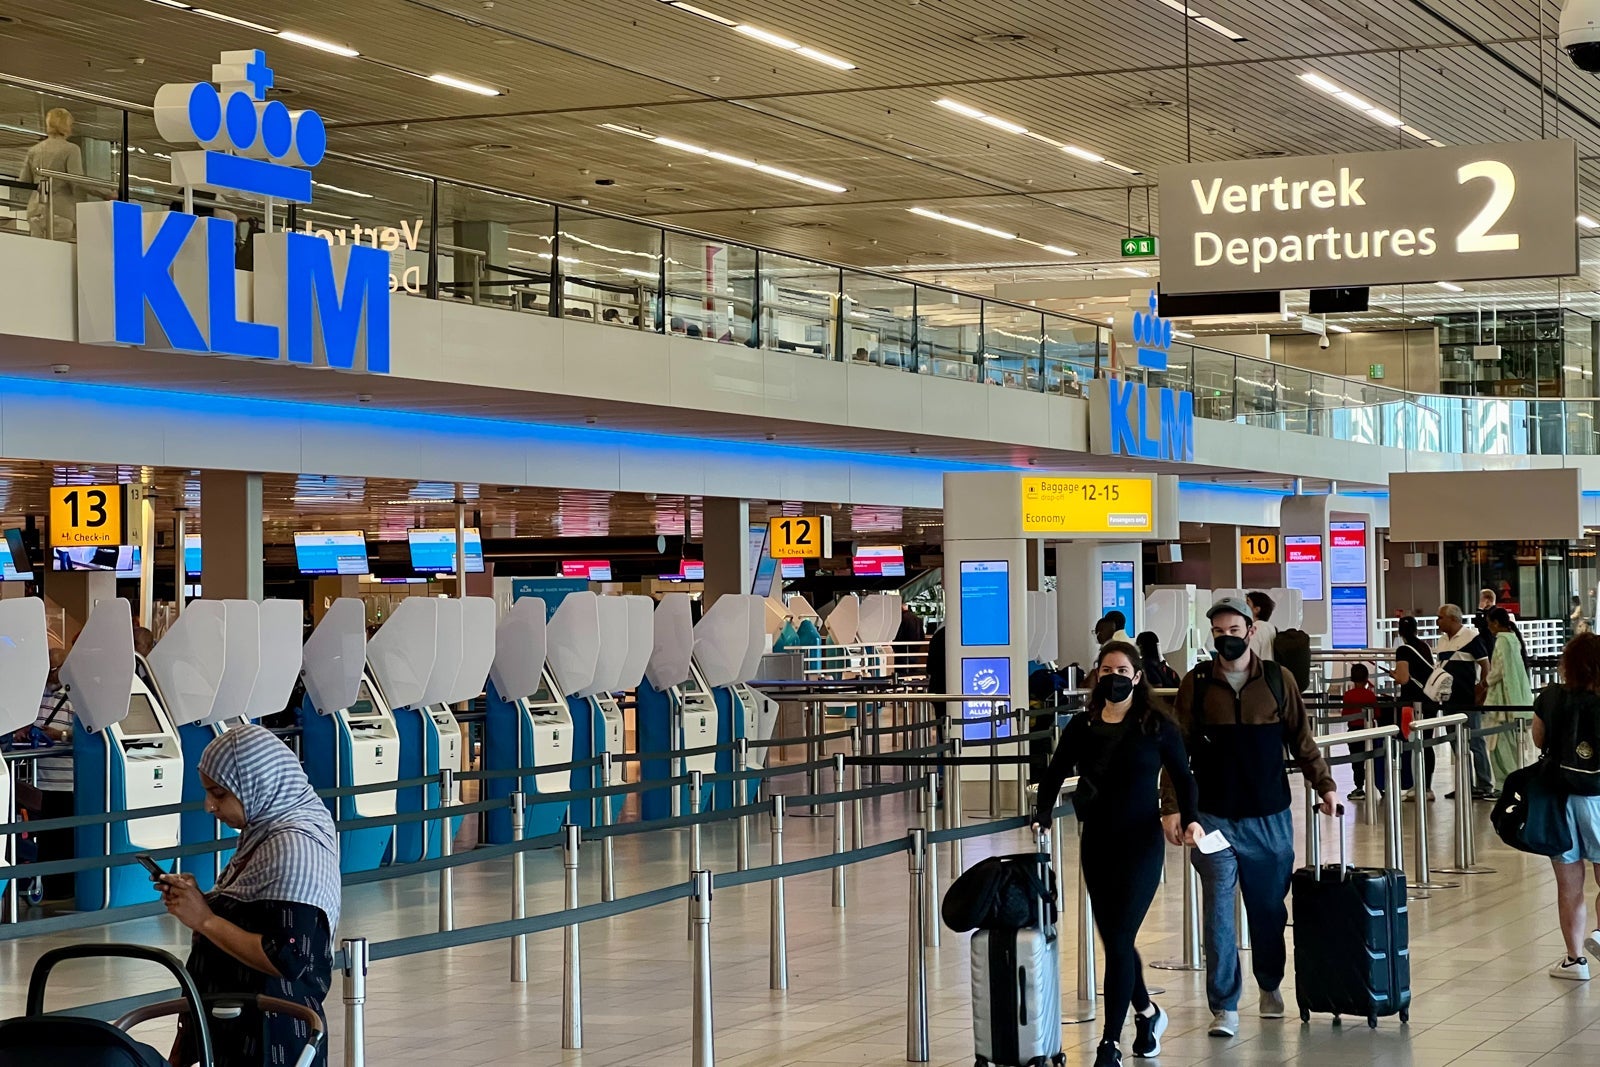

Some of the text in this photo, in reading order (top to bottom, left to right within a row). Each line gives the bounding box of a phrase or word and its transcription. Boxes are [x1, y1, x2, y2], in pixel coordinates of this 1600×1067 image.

[1191, 167, 1366, 215] Vertrek
[1456, 159, 1520, 253] 2
[1193, 226, 1437, 274] Departures
[113, 200, 390, 374] KLM
[1108, 378, 1194, 463] KLM
[130, 489, 140, 500] 13
[1041, 481, 1120, 501] Baggage 12-15
[63, 489, 108, 528] 13
[1025, 513, 1066, 525] Economy
[74, 532, 110, 542] Check-in
[779, 519, 812, 545] 12
[787, 548, 814, 556] Check-in
[1246, 538, 1269, 555] 10
